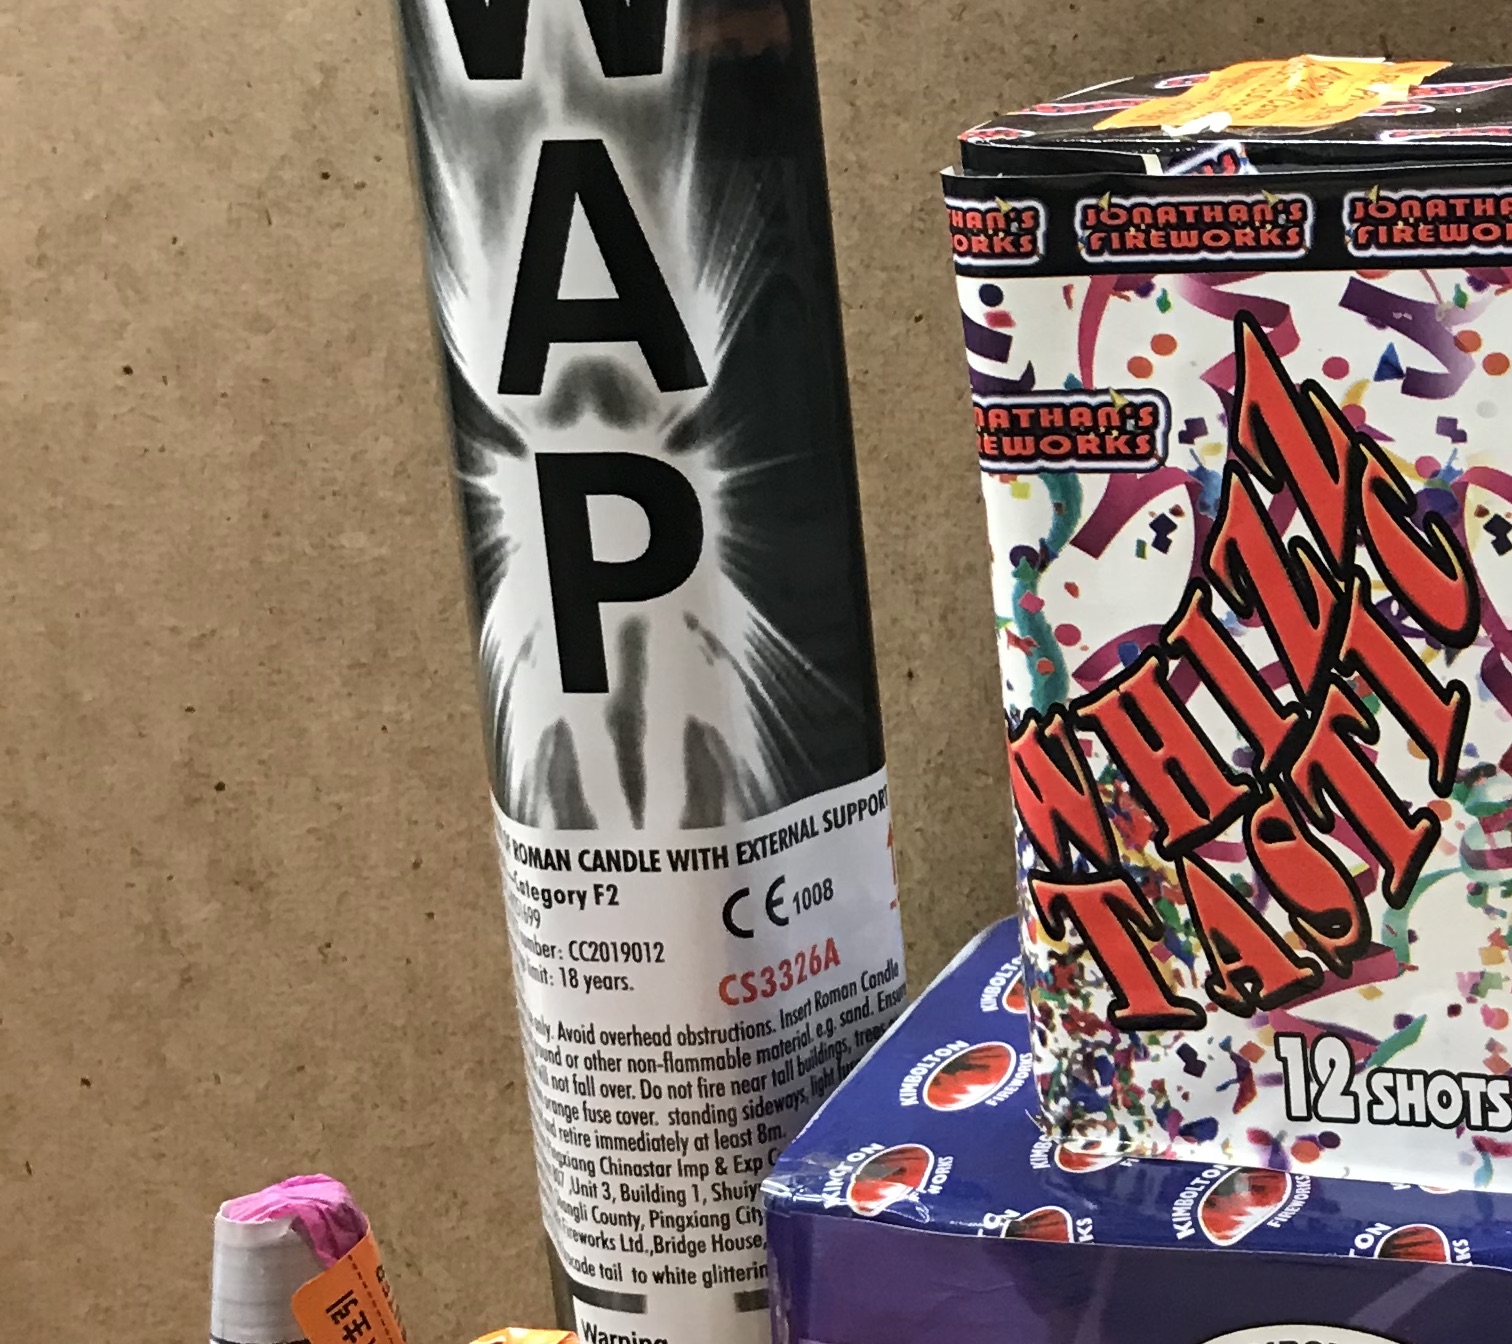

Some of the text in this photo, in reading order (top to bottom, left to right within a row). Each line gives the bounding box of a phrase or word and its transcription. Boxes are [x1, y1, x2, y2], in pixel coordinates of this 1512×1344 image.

[1085, 202, 1304, 228] JONATHAN'S
[1089, 227, 1301, 253] FIREWORKS
[511, 838, 572, 873] ROMAN
[577, 849, 662, 873] CANDLE
[666, 845, 730, 872] WITH
[736, 815, 820, 867] EXTERNAL
[593, 883, 620, 906] F2
[792, 877, 835, 915] 1008
[568, 940, 666, 964] CC2019012
[559, 967, 635, 995] 18 years.
[718, 936, 842, 1006] CS3326A
[557, 1020, 596, 1046] Avoid
[599, 1023, 673, 1047] overhead
[676, 1019, 777, 1047] obstructions.
[779, 997, 812, 1030] Insert
[814, 981, 857, 1013] Roman
[565, 1054, 580, 1070] or
[583, 1049, 623, 1073] other
[627, 1046, 752, 1074] non-flammable
[839, 995, 875, 1028] sand.
[551, 1074, 570, 1095] not
[572, 1072, 596, 1098] fall
[600, 1085, 637, 1100] over.
[640, 1078, 663, 1100] Do
[667, 1080, 693, 1100] not
[697, 1076, 726, 1099] fire
[730, 1073, 769, 1097] near
[771, 1060, 796, 1088] tall
[797, 1039, 852, 1078] buildings,
[898, 1039, 971, 1107] KIMBOLTON
[1275, 1032, 1362, 1124] 12
[582, 1099, 613, 1126] fuse
[615, 1109, 660, 1127] cover.
[667, 1102, 739, 1128] standing
[558, 1126, 592, 1150] retire
[594, 1129, 690, 1157] immediately
[693, 1131, 710, 1152] at
[714, 1128, 753, 1151] least
[756, 1122, 787, 1145] 8m.
[599, 1155, 672, 1179] Chinastar
[677, 1158, 710, 1181] Imp
[714, 1156, 729, 1176] &
[733, 1153, 764, 1176] Exp
[601, 1182, 708, 1207] 3, Building 1,
[591, 1205, 646, 1233] County,
[649, 1208, 731, 1233] Pingxiang
[711, 1232, 768, 1253] House,
[600, 1261, 698, 1286] tail to white
